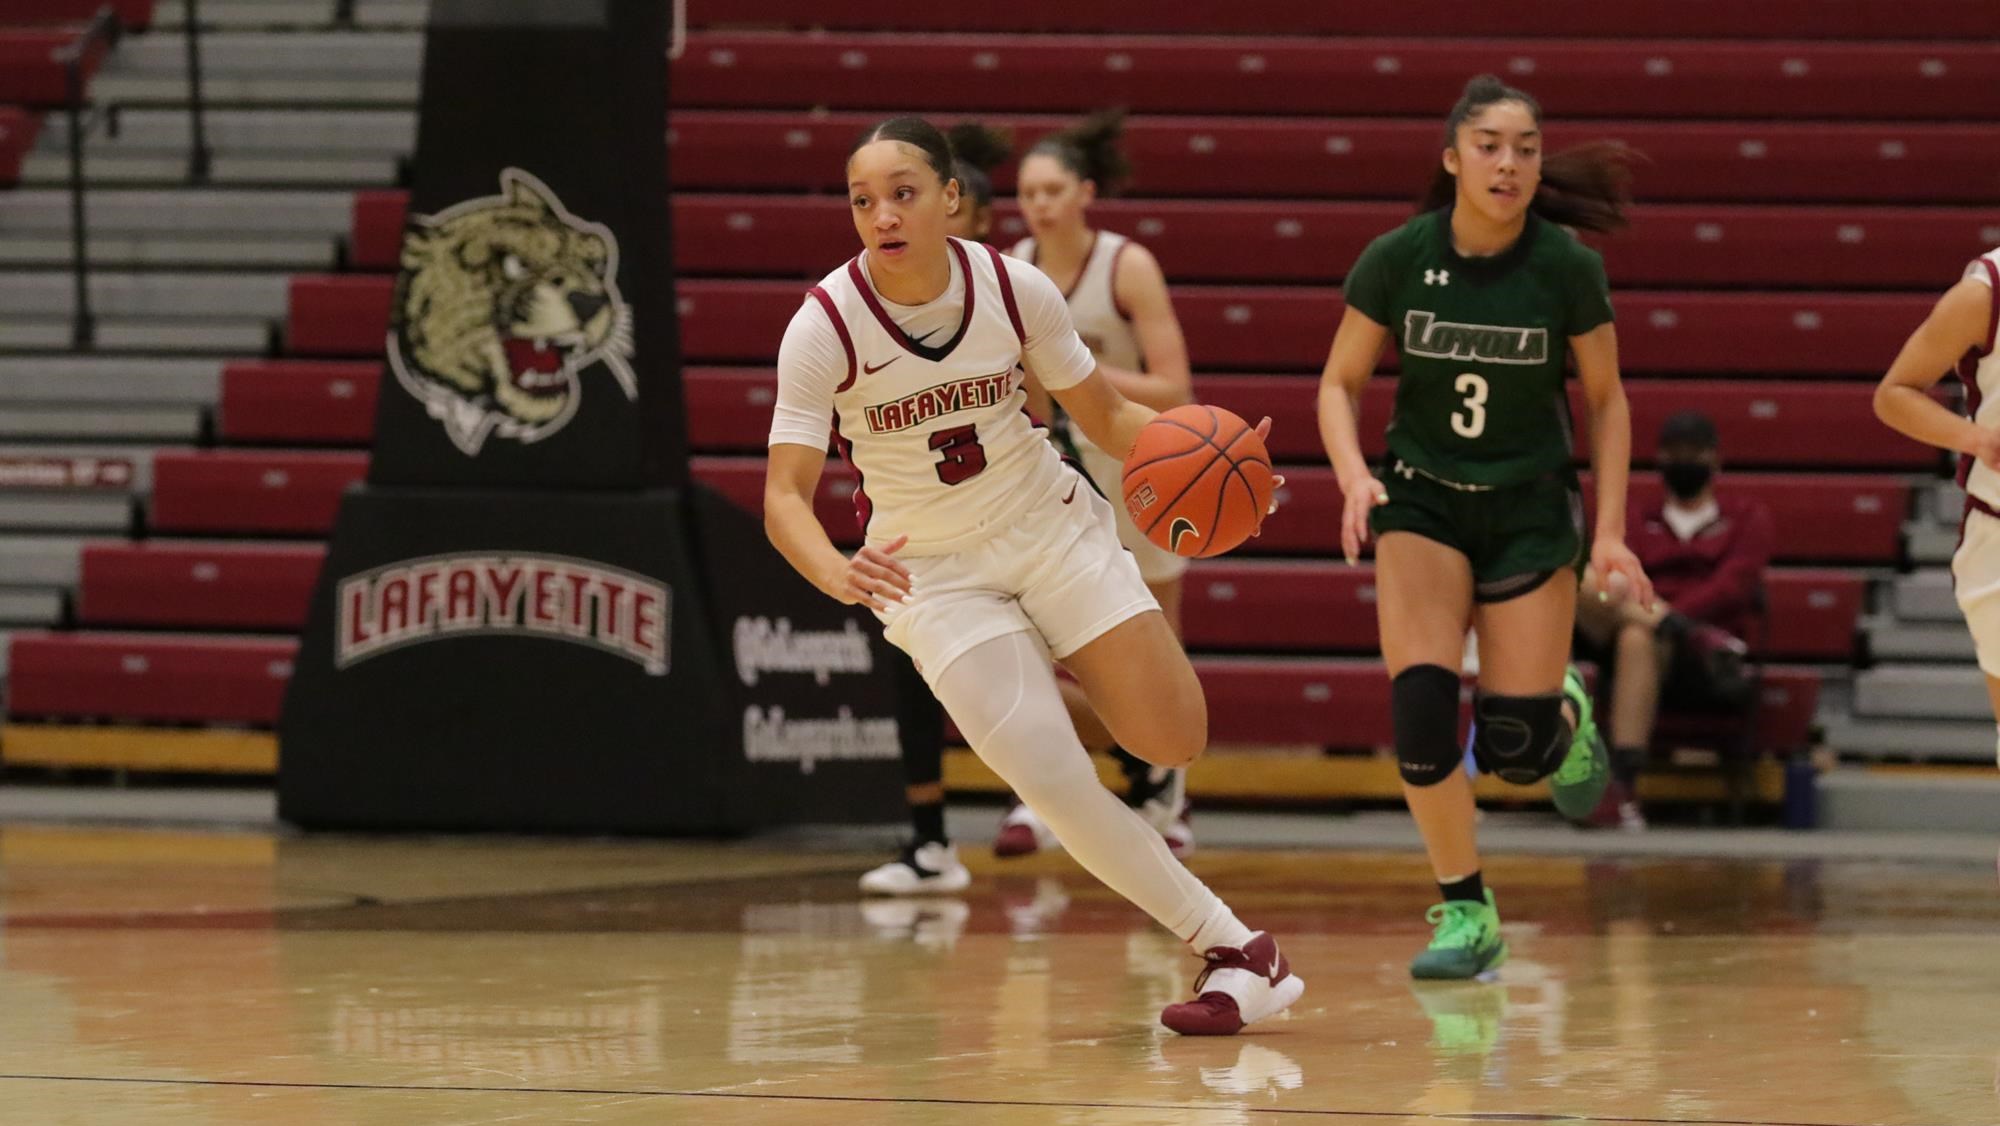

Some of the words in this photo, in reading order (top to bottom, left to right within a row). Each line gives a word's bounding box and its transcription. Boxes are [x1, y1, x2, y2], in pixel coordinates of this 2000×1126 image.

[865, 367, 1012, 434] LAFAYETTE
[1451, 373, 1489, 438] 3
[928, 423, 988, 486] 3
[337, 552, 670, 673] LAFAYETTE
